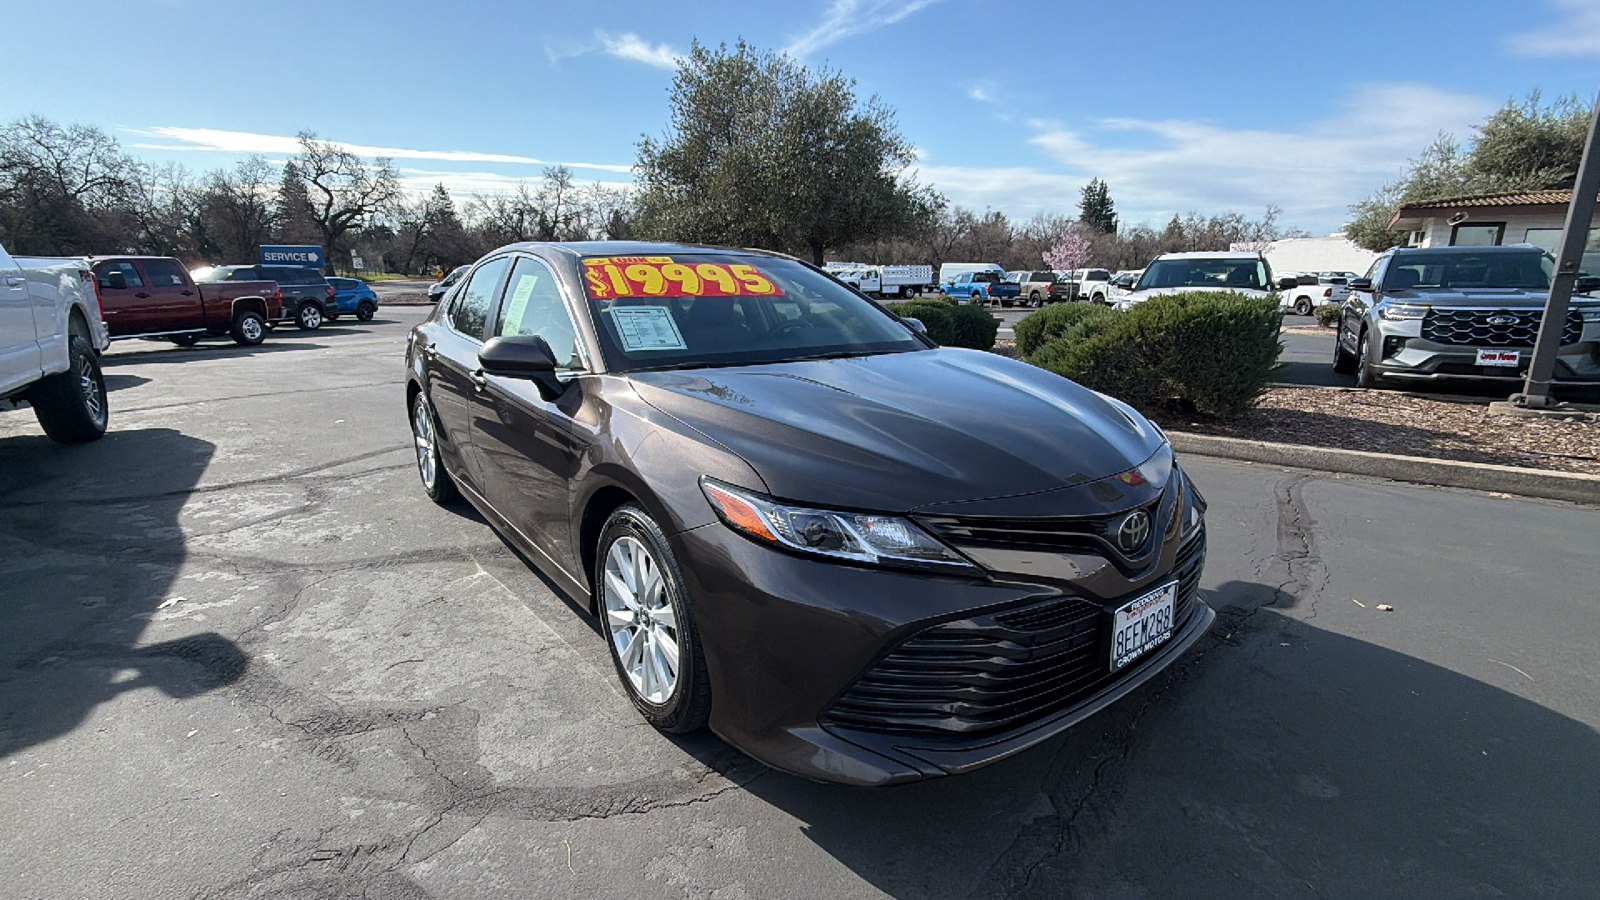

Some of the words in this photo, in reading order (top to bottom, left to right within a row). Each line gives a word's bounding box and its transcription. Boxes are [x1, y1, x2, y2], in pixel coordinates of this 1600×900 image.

[264, 252, 307, 261] SERVICE
[585, 264, 775, 296] $19995
[1131, 589, 1165, 610] REDDING
[1116, 605, 1171, 657] 8EFM288
[1117, 646, 1143, 667] CROWN
[1144, 630, 1171, 652] MOTORS
